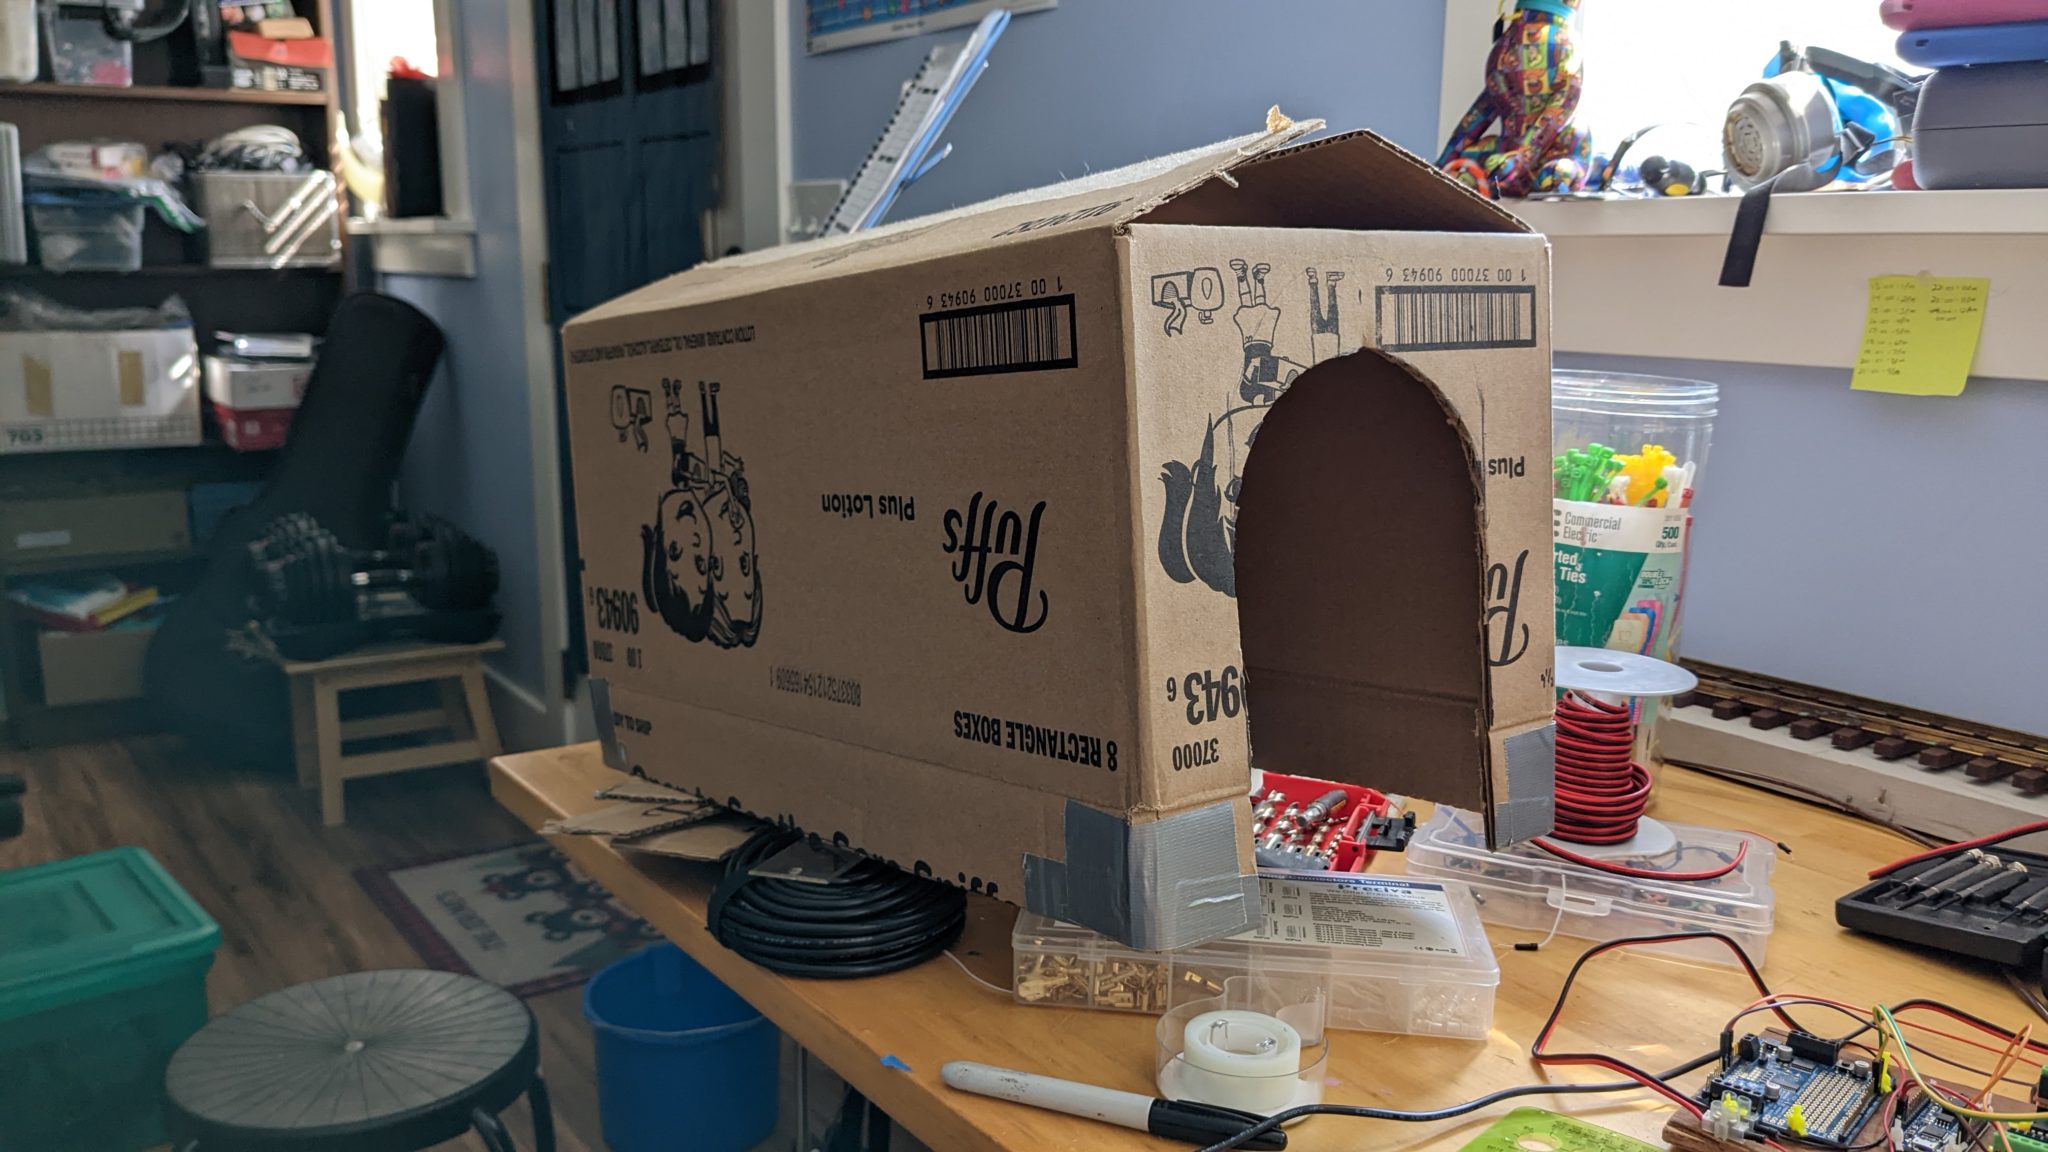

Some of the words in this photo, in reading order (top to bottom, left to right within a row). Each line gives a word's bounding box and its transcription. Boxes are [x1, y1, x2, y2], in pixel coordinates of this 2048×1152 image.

[1057, 276, 1063, 292] 1
[1385, 268, 1393, 282] 6
[1402, 268, 1443, 282] 90943
[1451, 268, 1489, 282] 37000
[1497, 268, 1512, 282] 00
[1520, 269, 1527, 282] 1
[984, 282, 1022, 302] 37000
[1031, 278, 1046, 295] 00
[926, 295, 933, 310] 6
[940, 288, 976, 308] 90943
[1488, 456, 1525, 479] Plus
[822, 494, 874, 519] Lotion
[878, 495, 915, 521] Plus
[1564, 512, 1622, 530] Commercial
[1662, 526, 1679, 539] 500
[942, 491, 1049, 634] Puffs
[1560, 566, 1587, 584] Ties
[597, 587, 640, 635] 90943
[1166, 676, 1177, 702] 6
[1182, 665, 1246, 726] 943
[953, 710, 1002, 746] BOXES
[1005, 720, 1102, 768] RECTANGLE
[1106, 740, 1118, 772] 8
[1172, 737, 1220, 772] 37000
[1337, 884, 1413, 895] Preciva
[1360, 879, 1411, 888] Terminal
